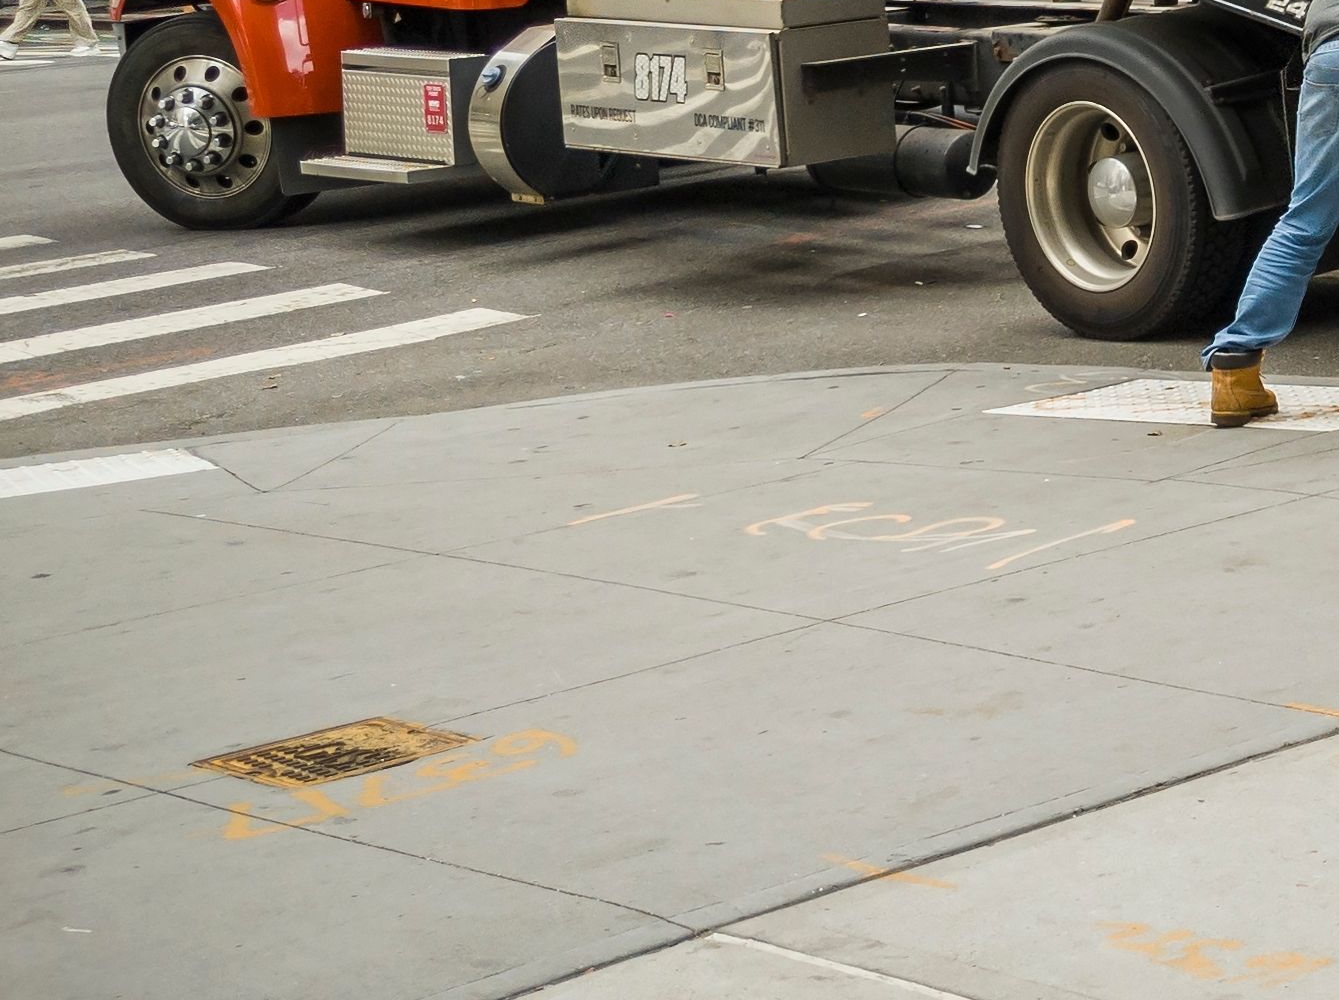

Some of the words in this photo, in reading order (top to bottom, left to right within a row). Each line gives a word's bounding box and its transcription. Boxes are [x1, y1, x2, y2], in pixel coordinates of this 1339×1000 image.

[634, 52, 688, 104] 8174
[570, 104, 591, 120] RATES
[591, 105, 609, 121] UPON
[608, 107, 637, 124] REQUEST
[694, 113, 707, 127] DCA
[708, 115, 746, 132] COMPLIANT
